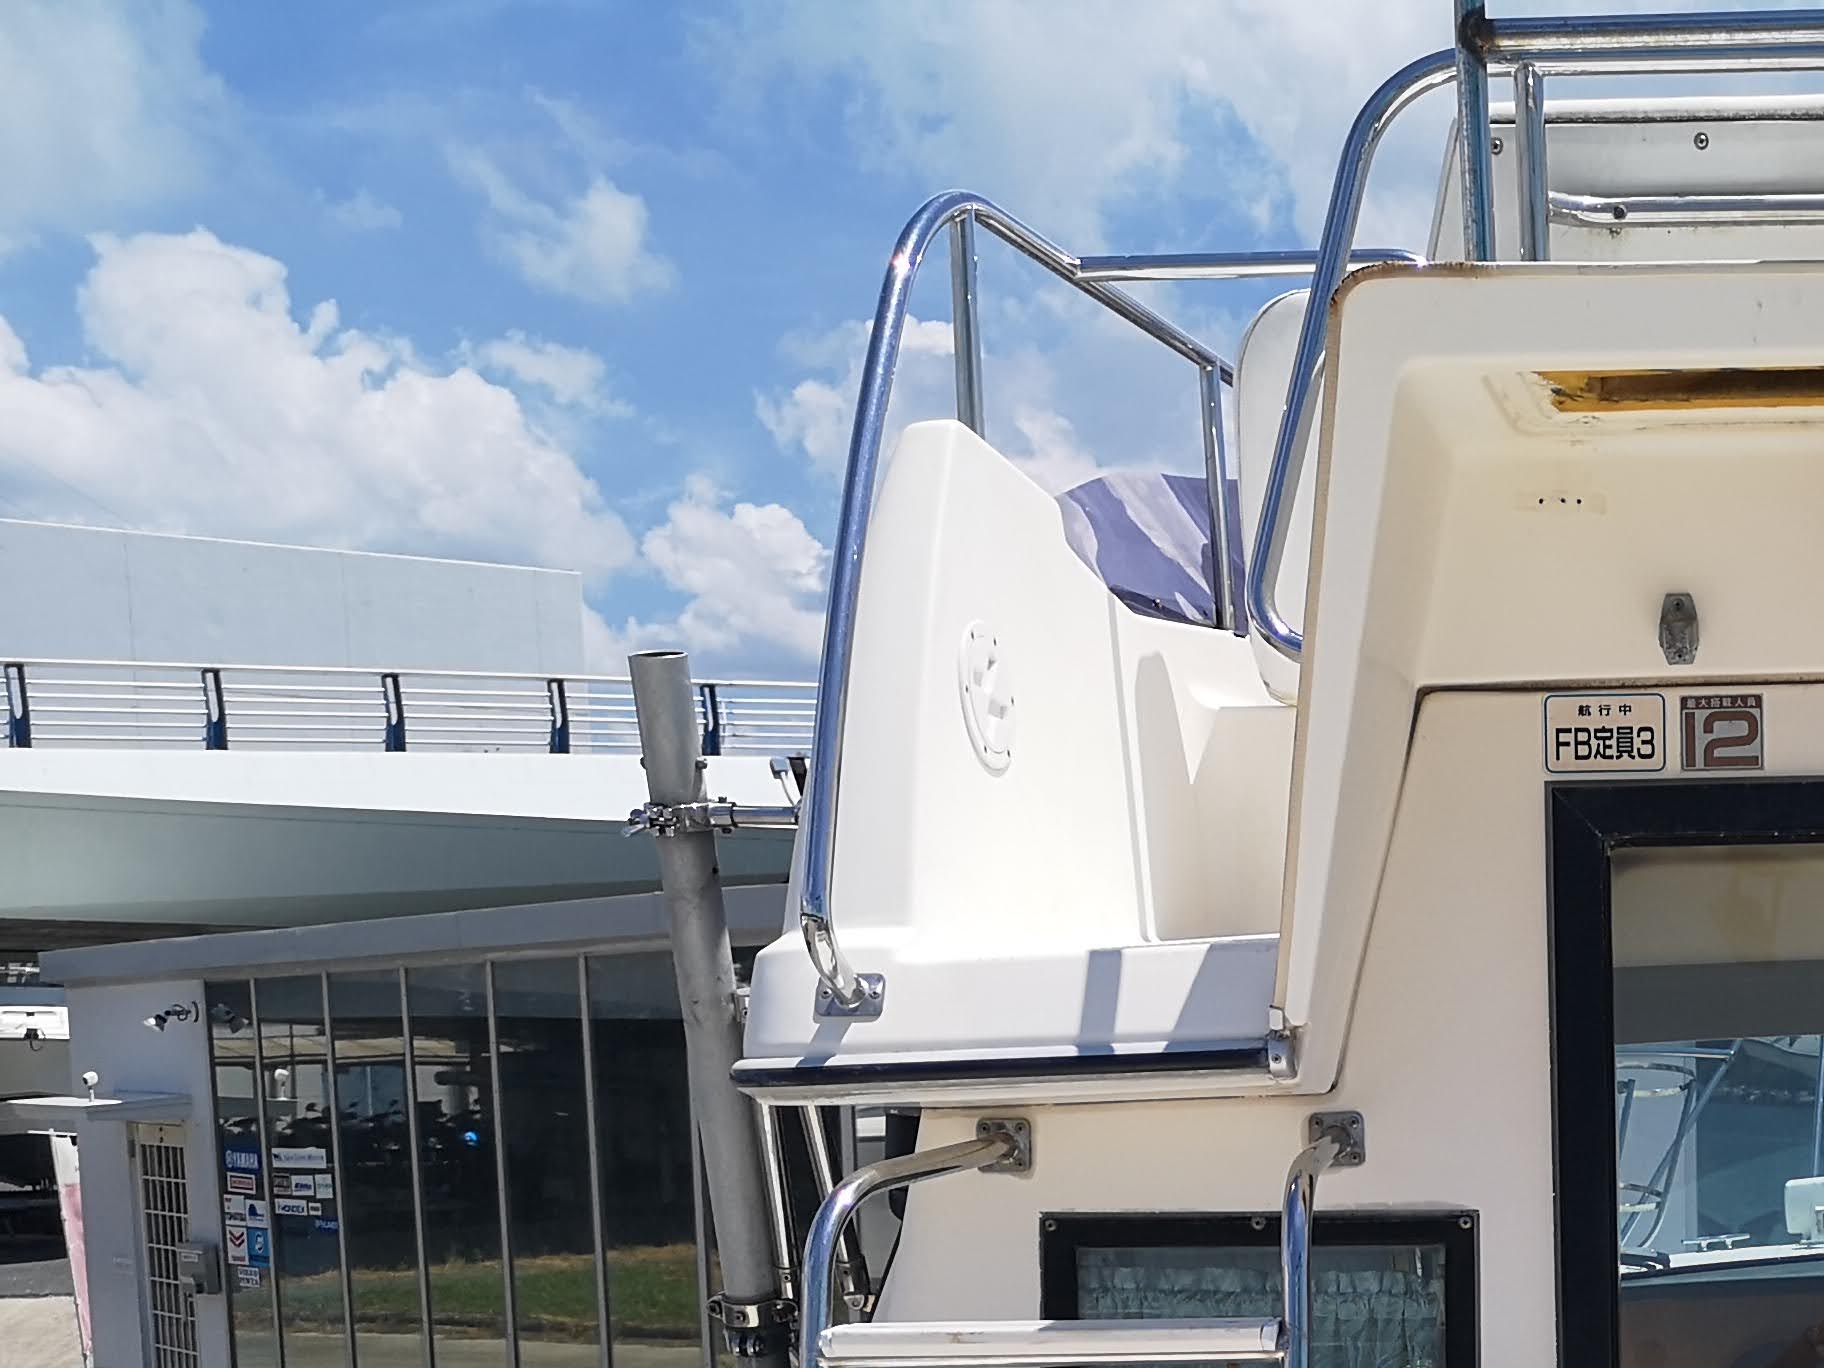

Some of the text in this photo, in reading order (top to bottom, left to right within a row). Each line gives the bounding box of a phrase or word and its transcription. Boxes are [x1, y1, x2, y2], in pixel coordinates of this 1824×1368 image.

[1577, 703, 1632, 717] 航行中
[1555, 725, 1656, 761] FB定員3
[1684, 710, 1760, 768] 12
